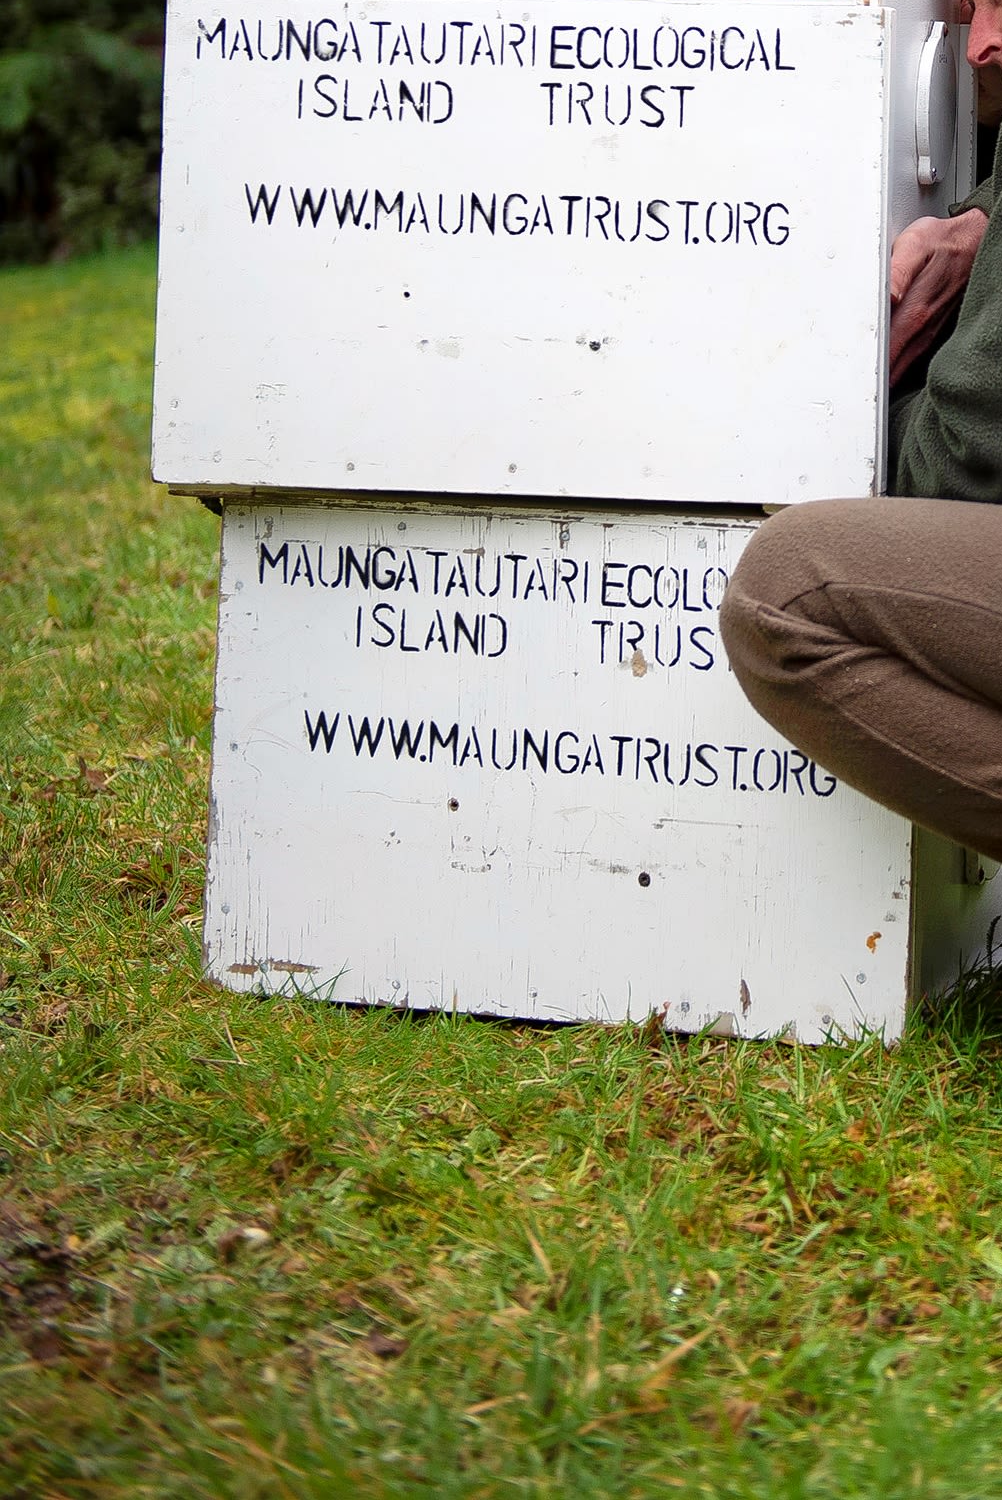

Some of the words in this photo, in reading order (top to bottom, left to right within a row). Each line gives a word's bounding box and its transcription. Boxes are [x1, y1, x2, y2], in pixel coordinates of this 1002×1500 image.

[196, 17, 536, 67] MAUNGATAUTARI
[550, 25, 796, 71] ECOLOGICAL
[298, 74, 453, 124] ISLAND
[541, 82, 695, 128] TRUST
[245, 183, 790, 246] WWW.MAUNGATRUST.ORG
[258, 542, 588, 604] MAUNGATAUTARI
[601, 562, 729, 612] ECOLO
[356, 603, 508, 658] ISLAND
[591, 620, 732, 672] TRUS
